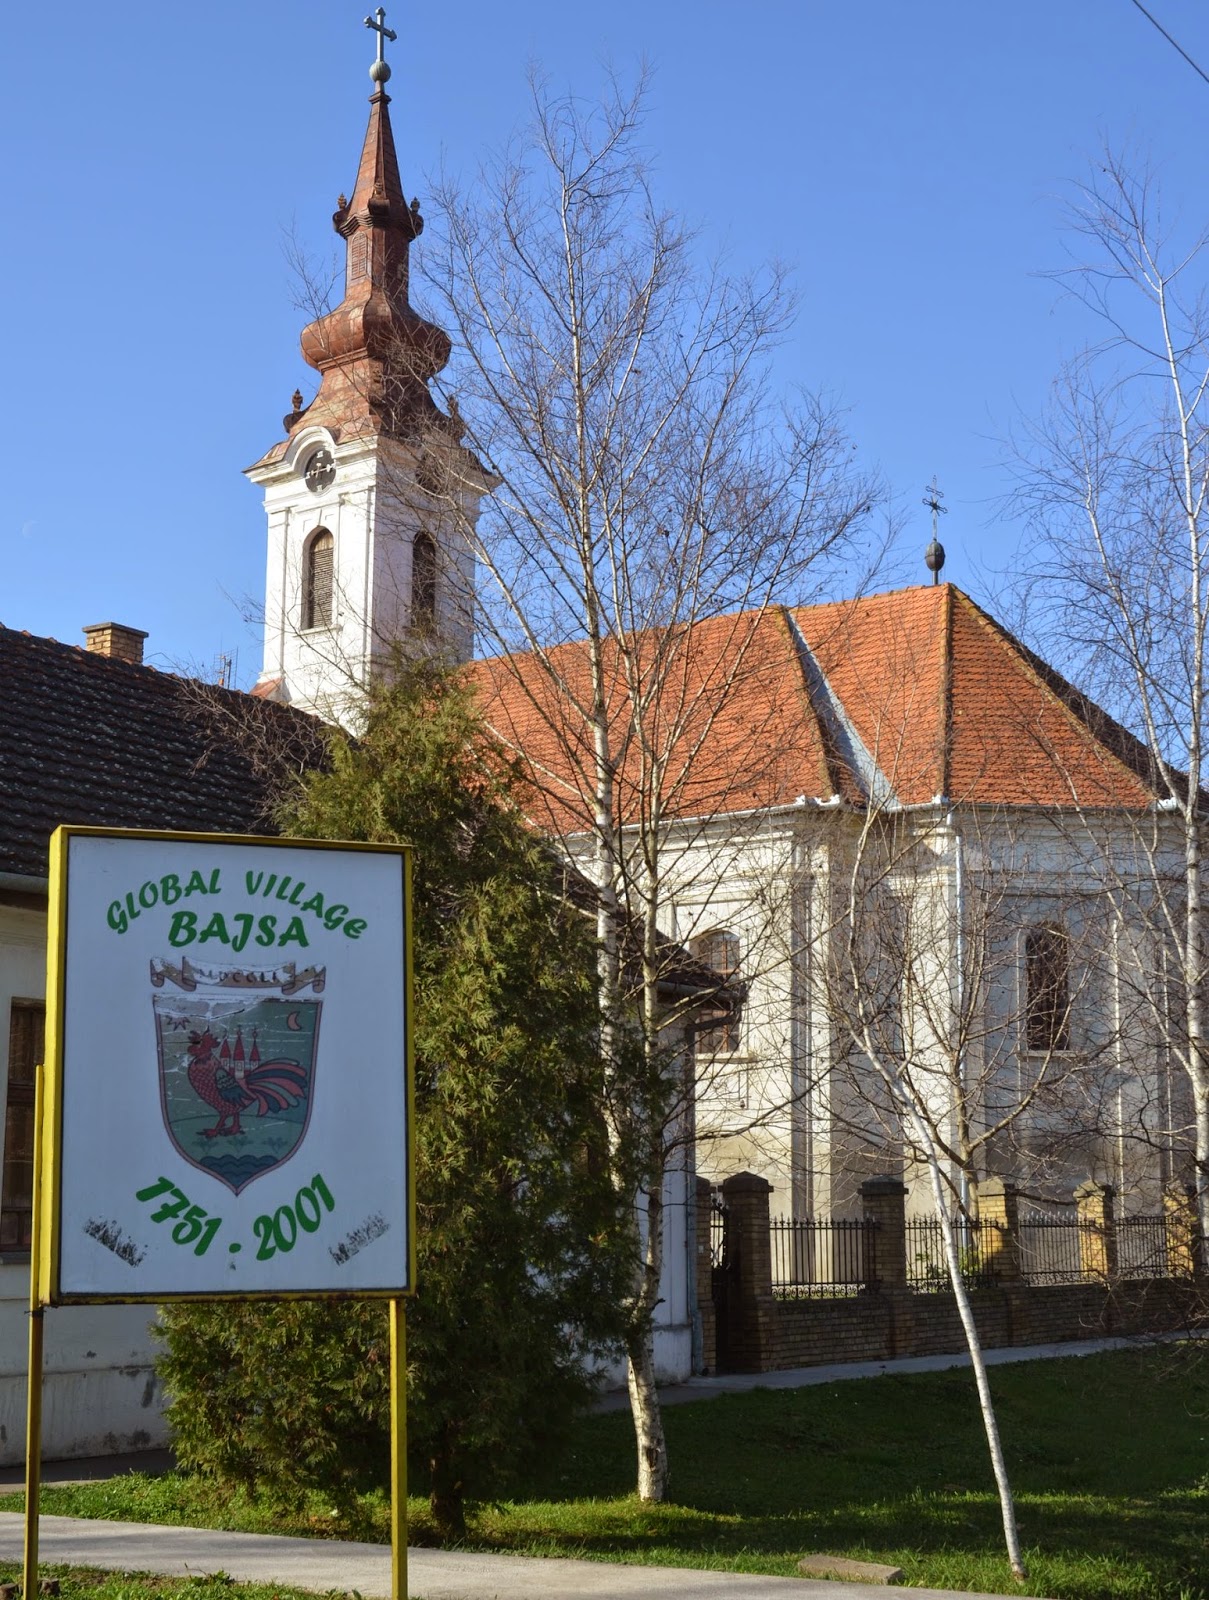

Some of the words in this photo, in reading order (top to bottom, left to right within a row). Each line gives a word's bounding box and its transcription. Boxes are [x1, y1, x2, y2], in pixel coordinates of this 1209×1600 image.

[106, 868, 222, 935] GLOBAL
[167, 911, 310, 952] BAJSA
[135, 1176, 222, 1257] 1751
[253, 1173, 336, 1261] 2001
